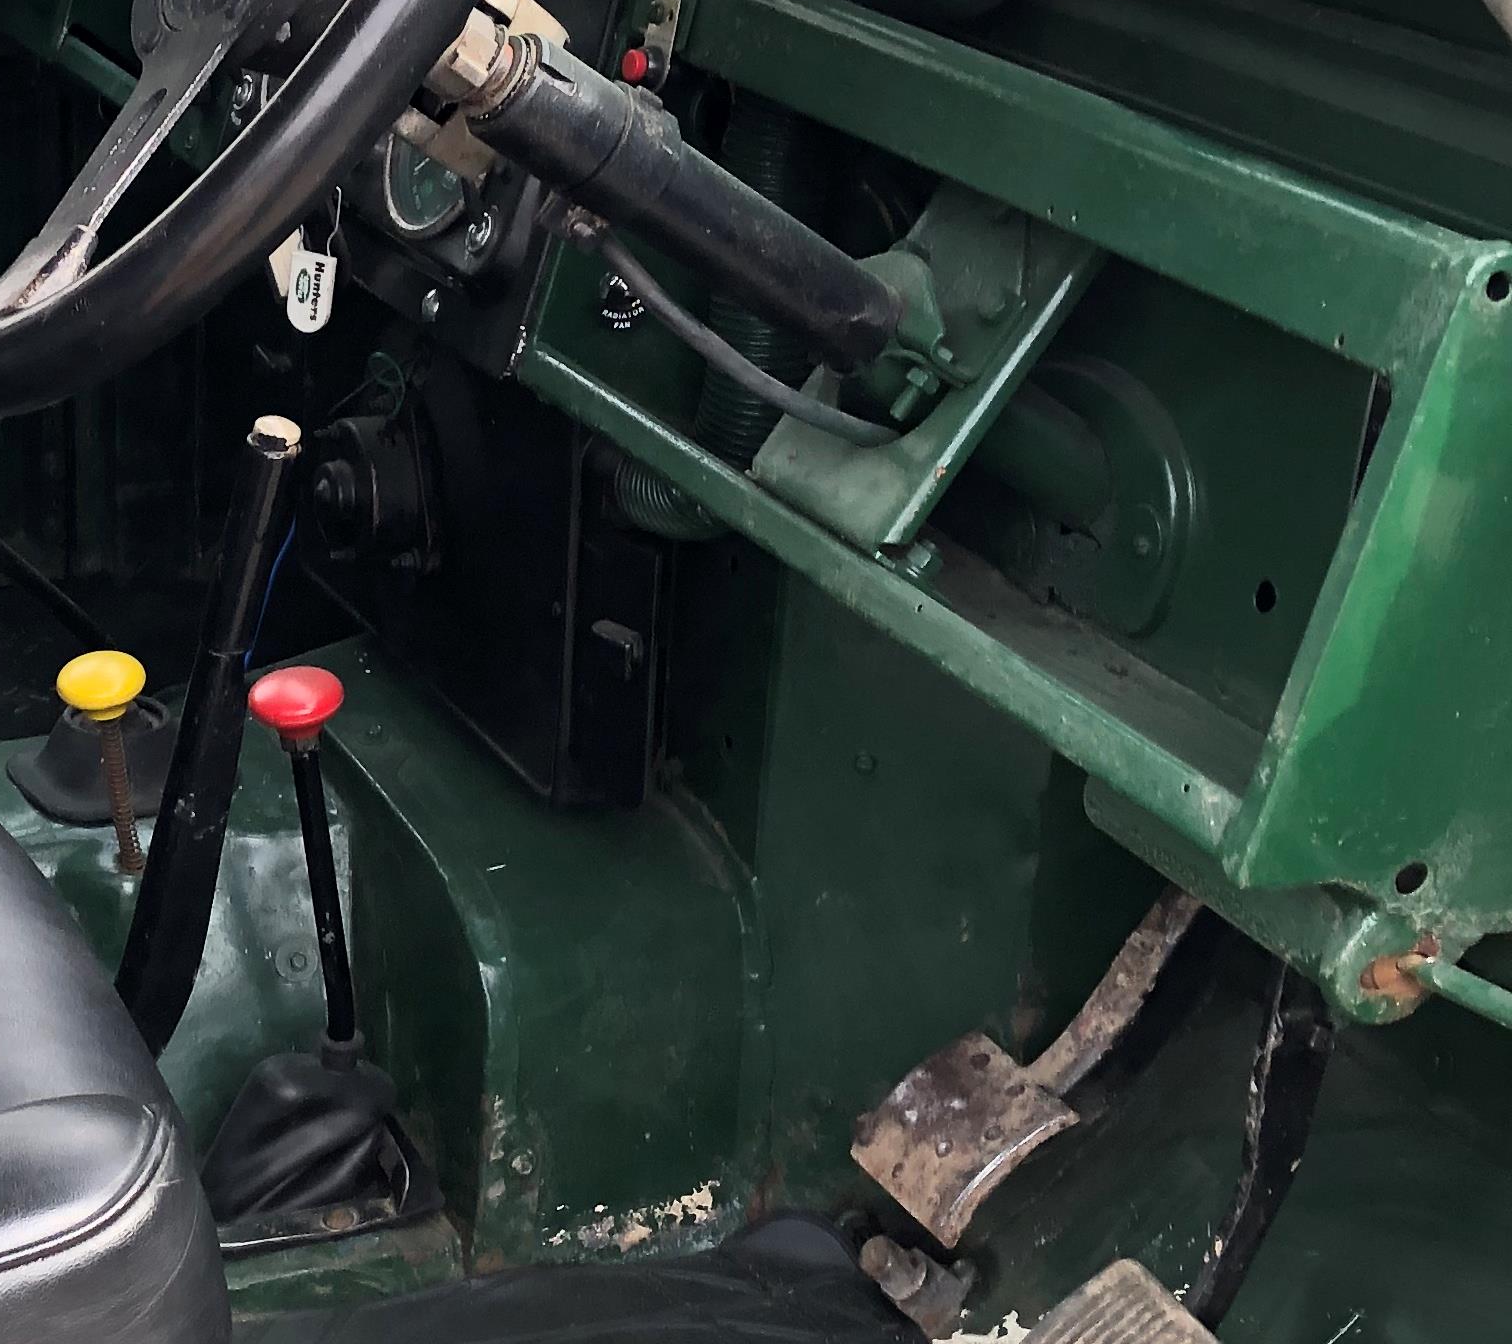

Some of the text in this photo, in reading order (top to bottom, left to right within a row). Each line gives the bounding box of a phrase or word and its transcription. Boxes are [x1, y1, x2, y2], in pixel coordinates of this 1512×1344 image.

[309, 261, 326, 321] Hunters
[601, 306, 645, 320] RADIATOR
[613, 321, 631, 329] FAN
